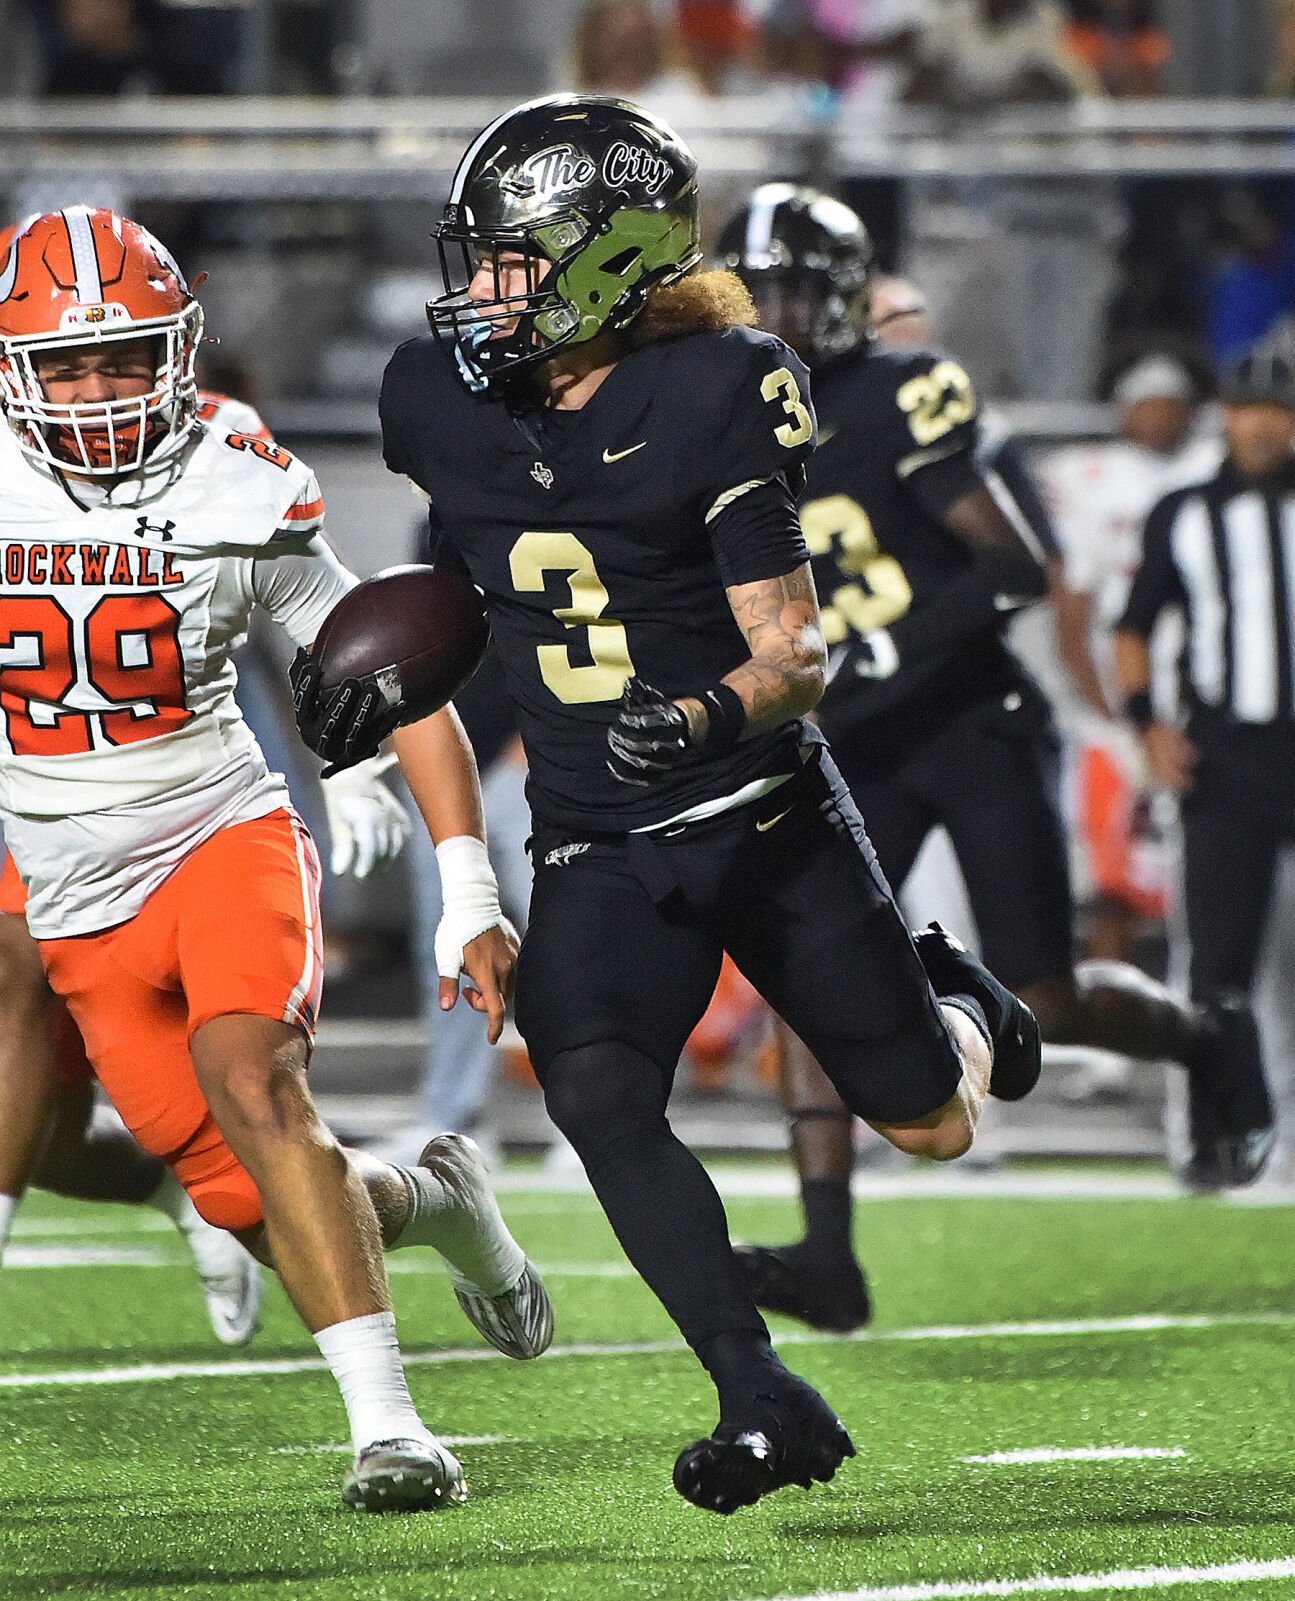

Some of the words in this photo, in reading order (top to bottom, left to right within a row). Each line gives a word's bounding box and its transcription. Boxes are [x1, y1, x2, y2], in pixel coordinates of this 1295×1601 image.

[524, 144, 597, 194] The
[602, 141, 674, 195] City
[760, 367, 813, 448] 3
[896, 360, 976, 446] 23
[0, 543, 185, 586] OCKWALL
[800, 495, 913, 644] 3
[508, 531, 636, 704] 3
[0, 591, 195, 756] 29
